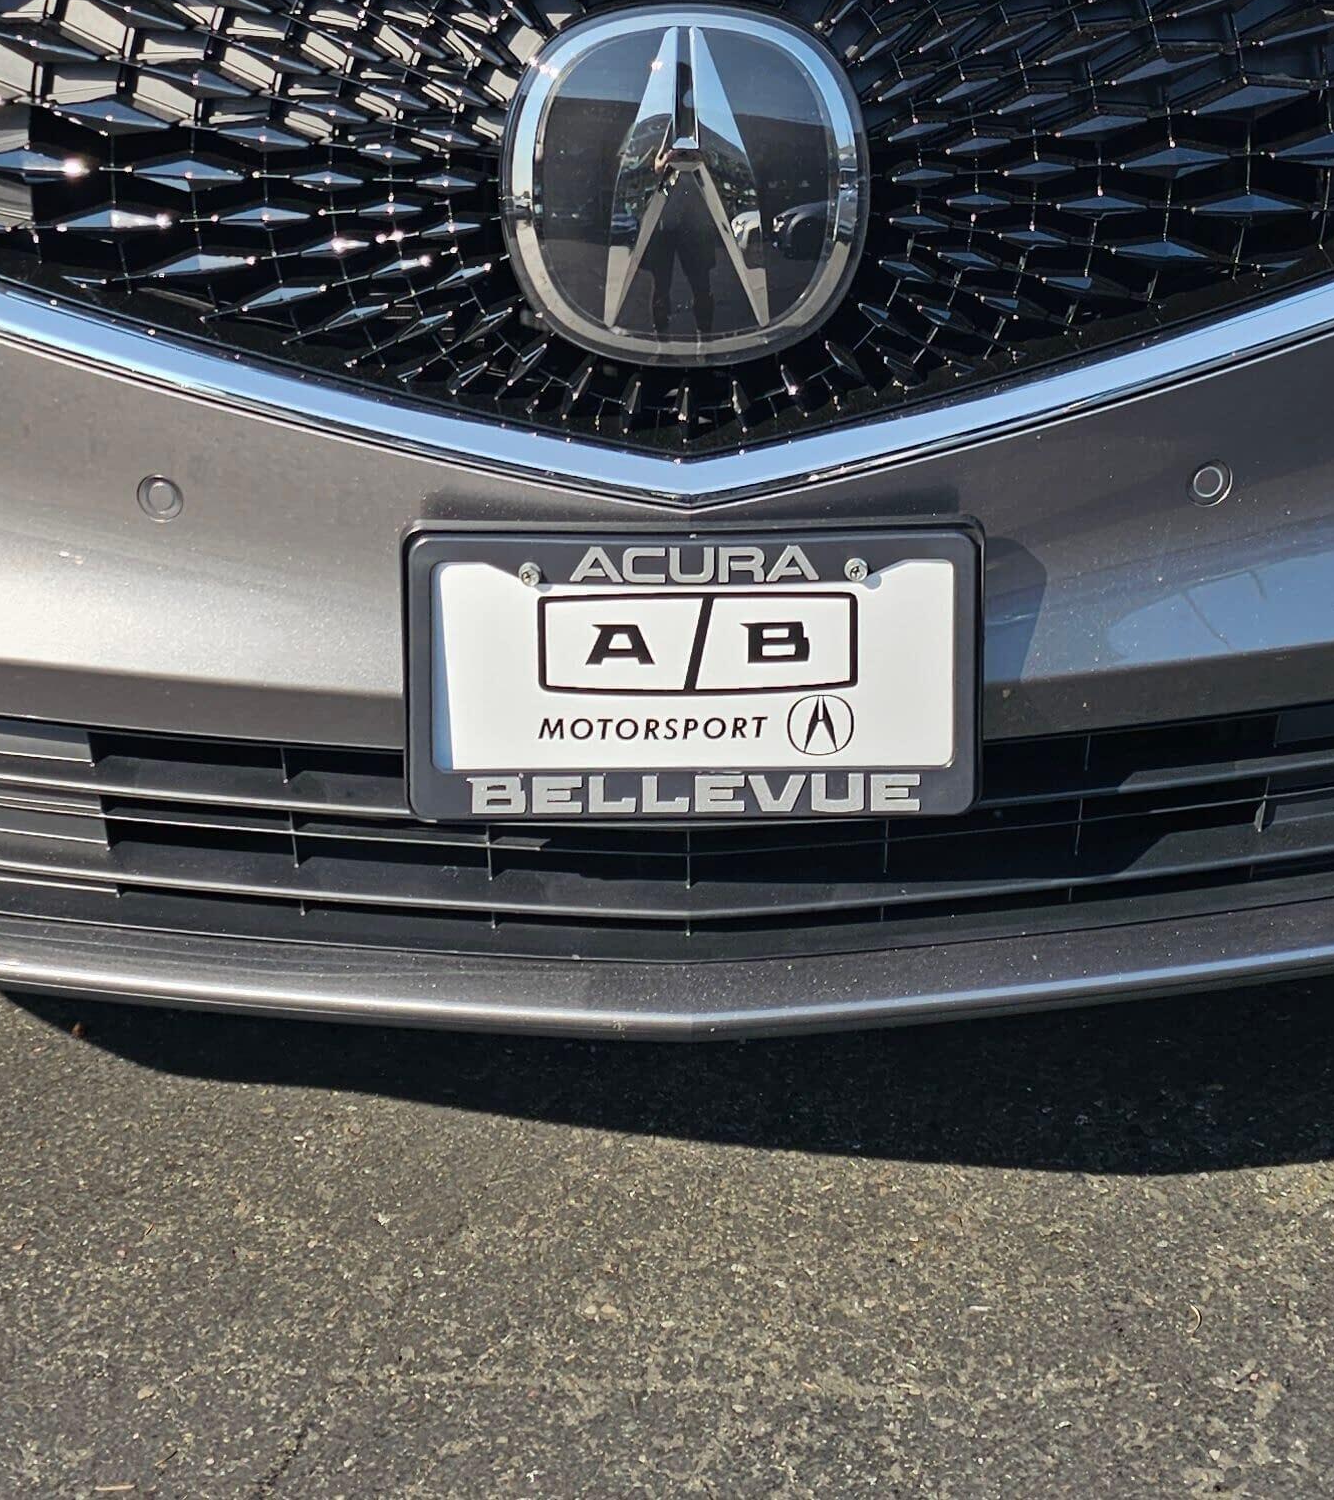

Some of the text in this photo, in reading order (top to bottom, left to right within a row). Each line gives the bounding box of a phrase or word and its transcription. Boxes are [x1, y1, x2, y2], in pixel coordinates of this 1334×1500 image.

[569, 545, 820, 585] ACURA
[538, 716, 769, 740] MOTORSPORT
[467, 772, 922, 815] BELLEVUE
